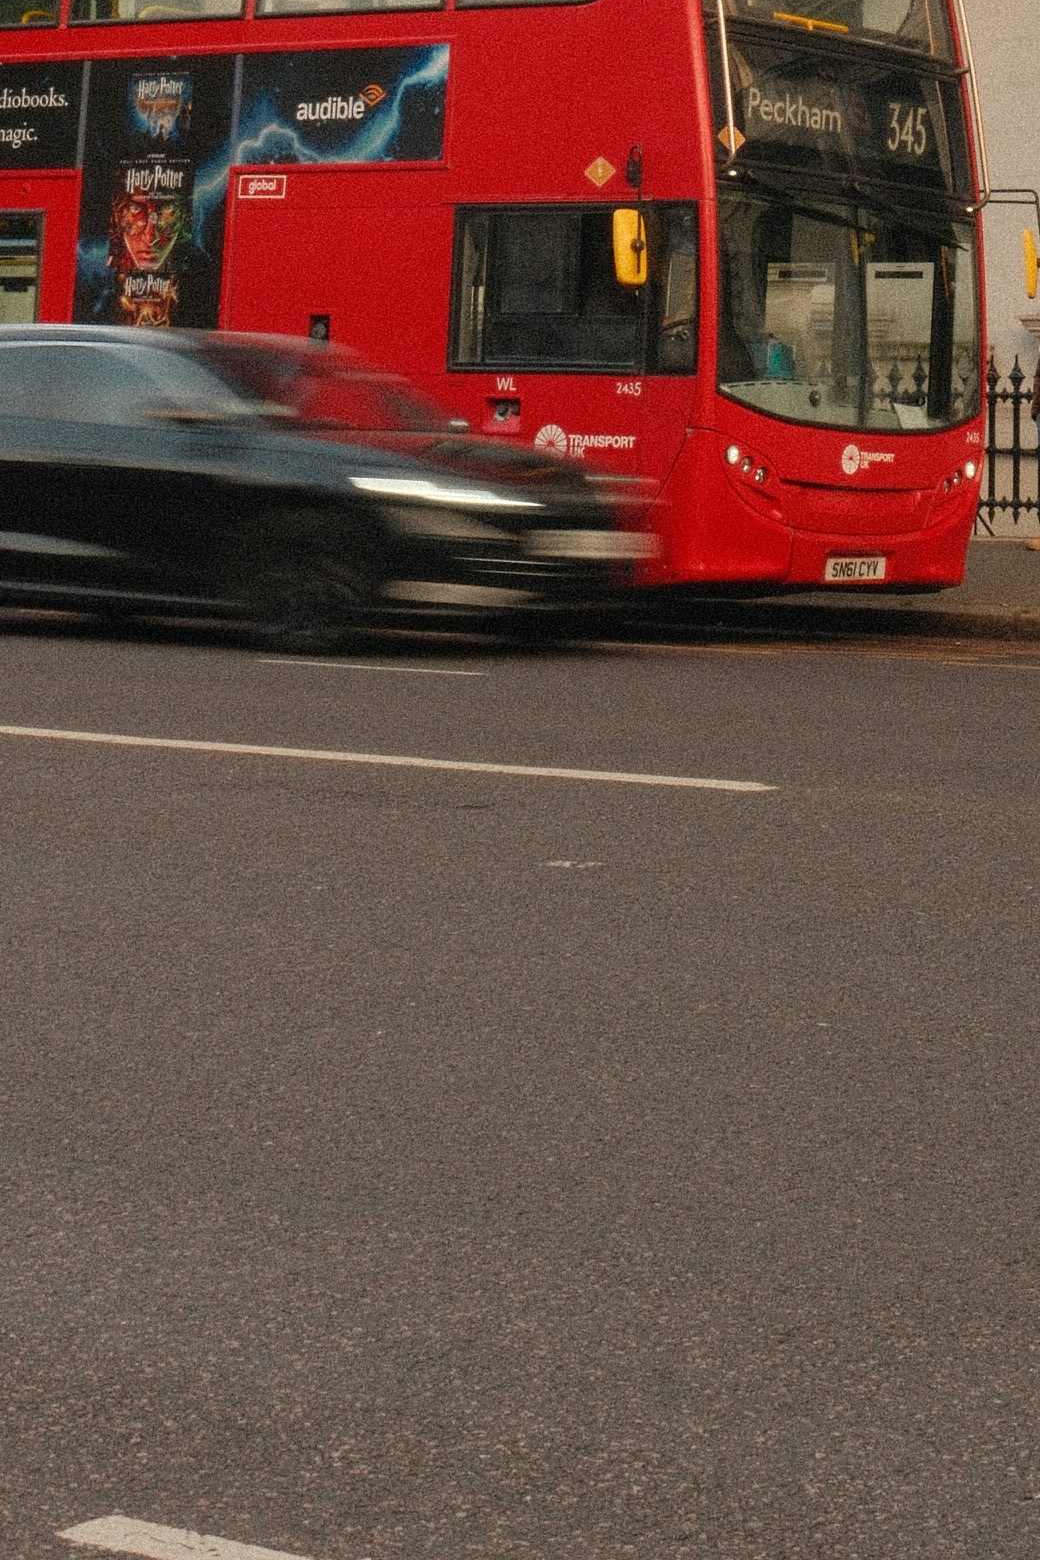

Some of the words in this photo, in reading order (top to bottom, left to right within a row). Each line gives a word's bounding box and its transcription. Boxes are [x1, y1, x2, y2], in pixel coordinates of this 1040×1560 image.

[296, 97, 365, 120] audible
[747, 88, 841, 133] Peckham
[888, 102, 927, 155] 345
[126, 168, 154, 194] Harry
[154, 165, 184, 191] Potter
[248, 179, 277, 195] global
[125, 276, 147, 297] Harry
[497, 377, 517, 391] WL
[616, 382, 642, 396] 2435
[568, 434, 636, 449] TRANSPORT
[860, 451, 895, 463] TRANSPORT
[858, 561, 879, 577] CYV
